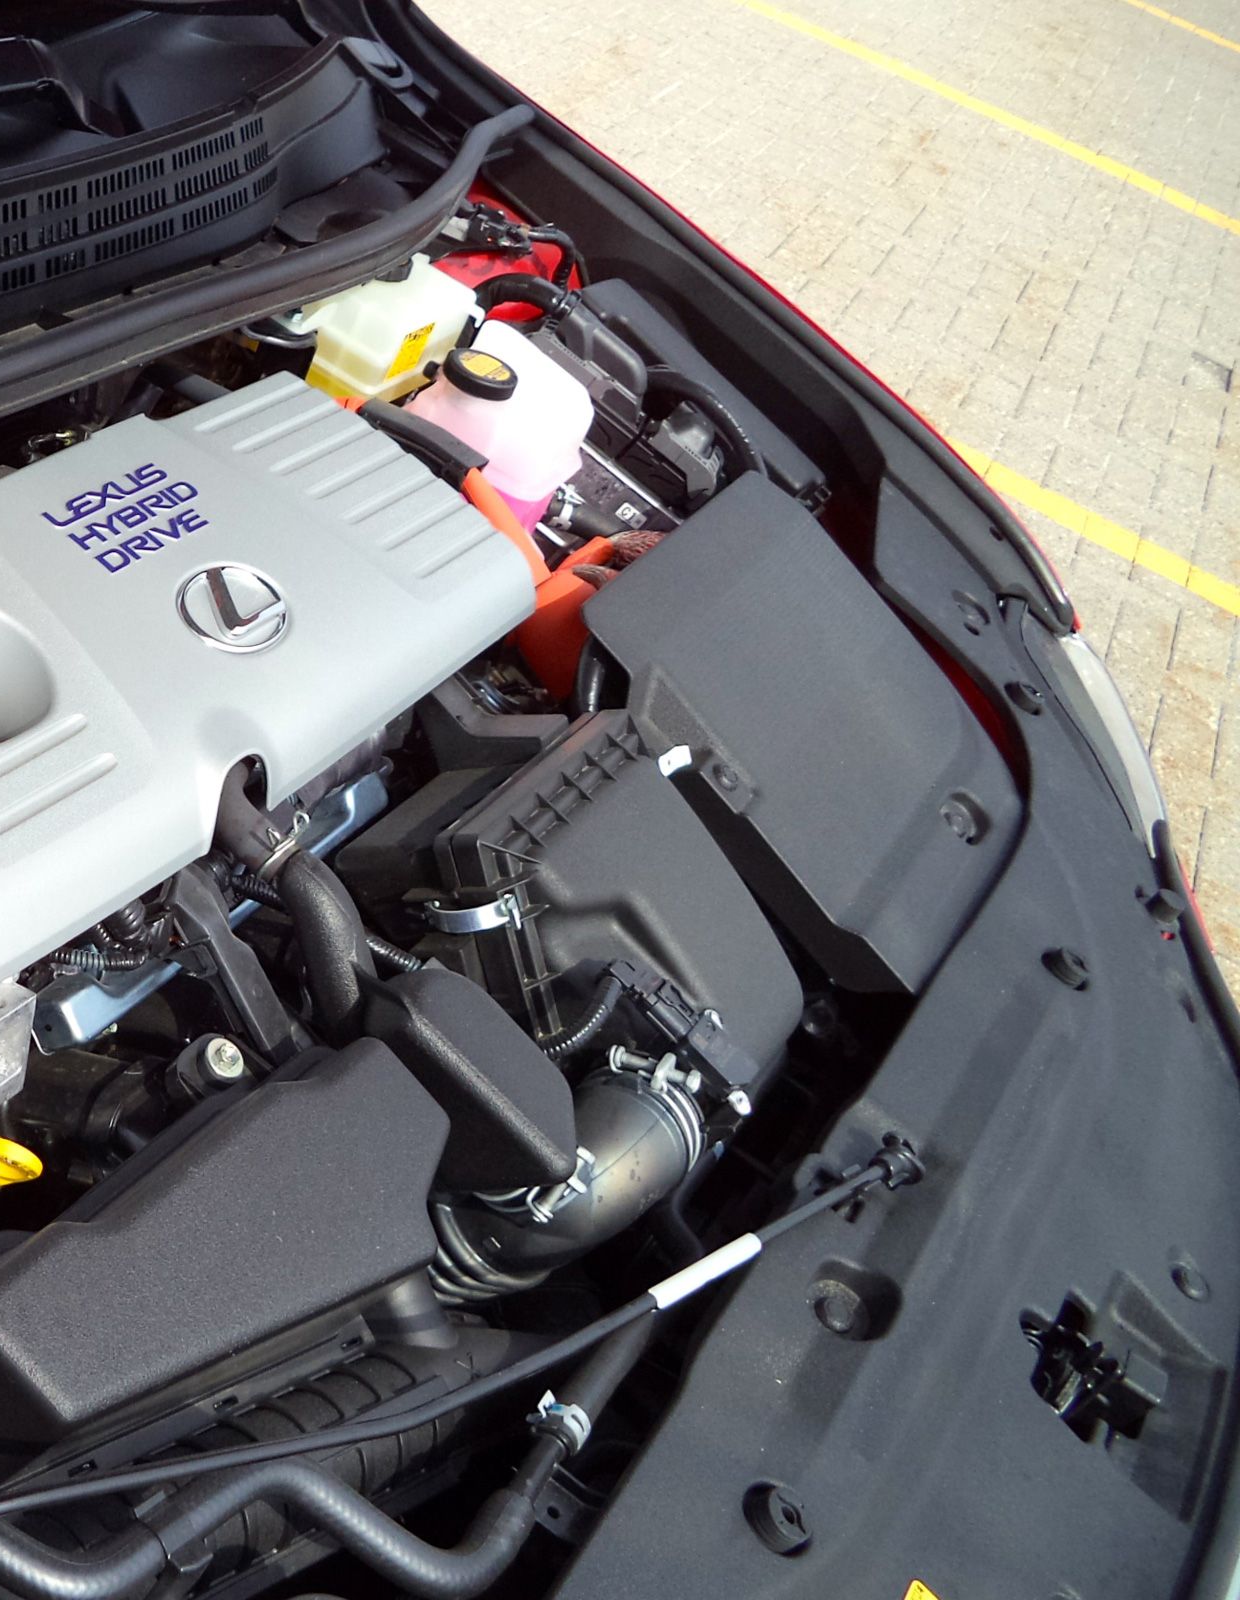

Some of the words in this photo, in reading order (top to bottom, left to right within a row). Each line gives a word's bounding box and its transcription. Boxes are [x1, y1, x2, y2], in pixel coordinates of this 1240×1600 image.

[41, 462, 168, 527] LEXUS
[68, 481, 199, 550] HYBRID
[94, 508, 209, 573] DRIVE
